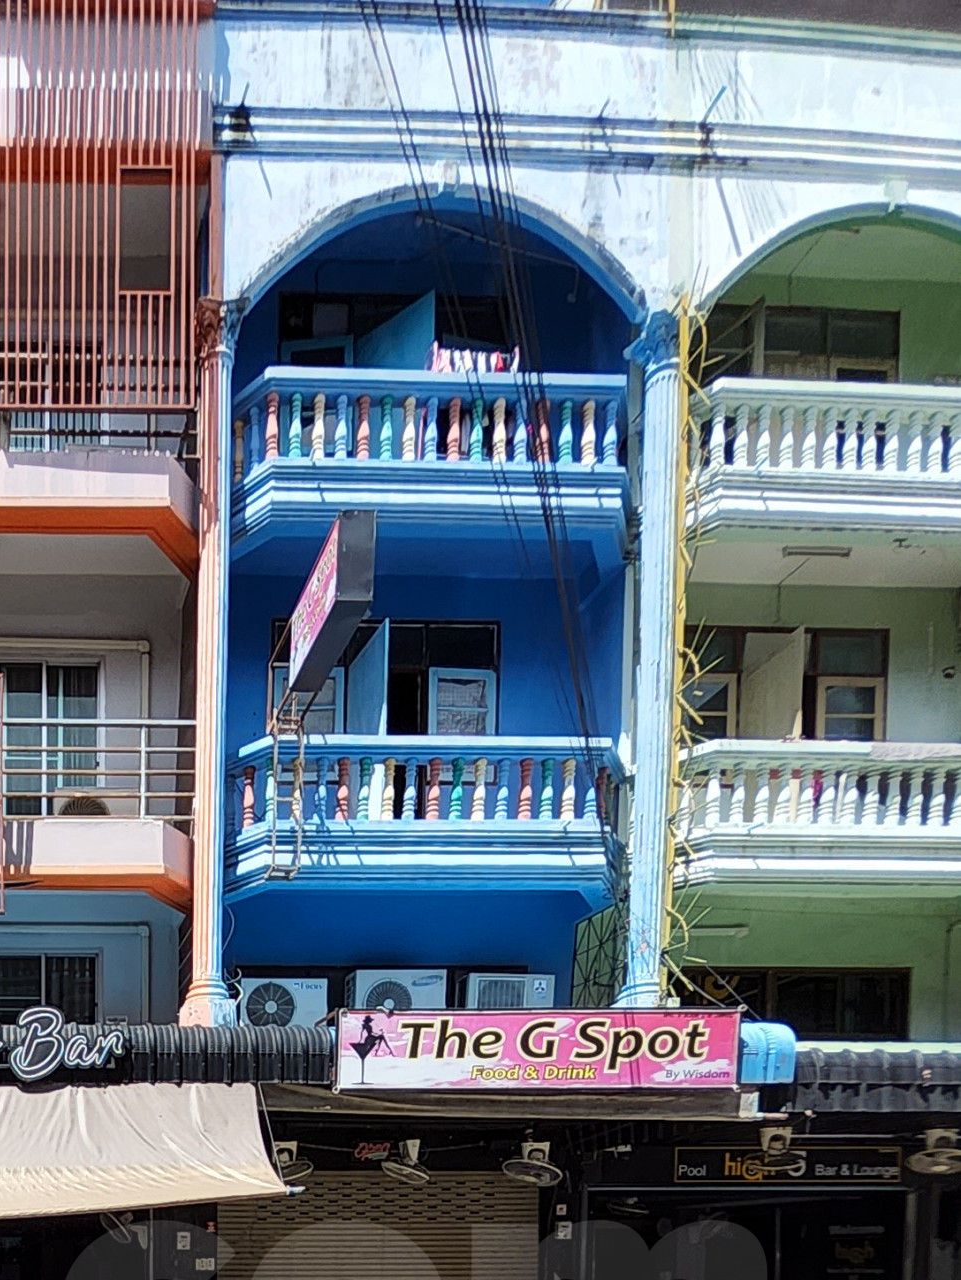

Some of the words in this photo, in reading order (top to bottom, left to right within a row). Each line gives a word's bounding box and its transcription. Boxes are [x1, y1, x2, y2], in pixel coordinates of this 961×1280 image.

[9, 1005, 126, 1081] Bar
[398, 1016, 506, 1060] The
[519, 1018, 560, 1061] G
[571, 1017, 711, 1074] Spot
[471, 1065, 521, 1081] Food
[524, 1065, 538, 1080] &
[543, 1065, 597, 1081] Drink
[666, 1069, 682, 1081] By
[683, 1068, 730, 1079] Wisdom
[678, 1164, 707, 1176] Pool
[815, 1164, 837, 1176] Bar
[840, 1164, 850, 1176] &
[853, 1164, 901, 1178] Lounge
